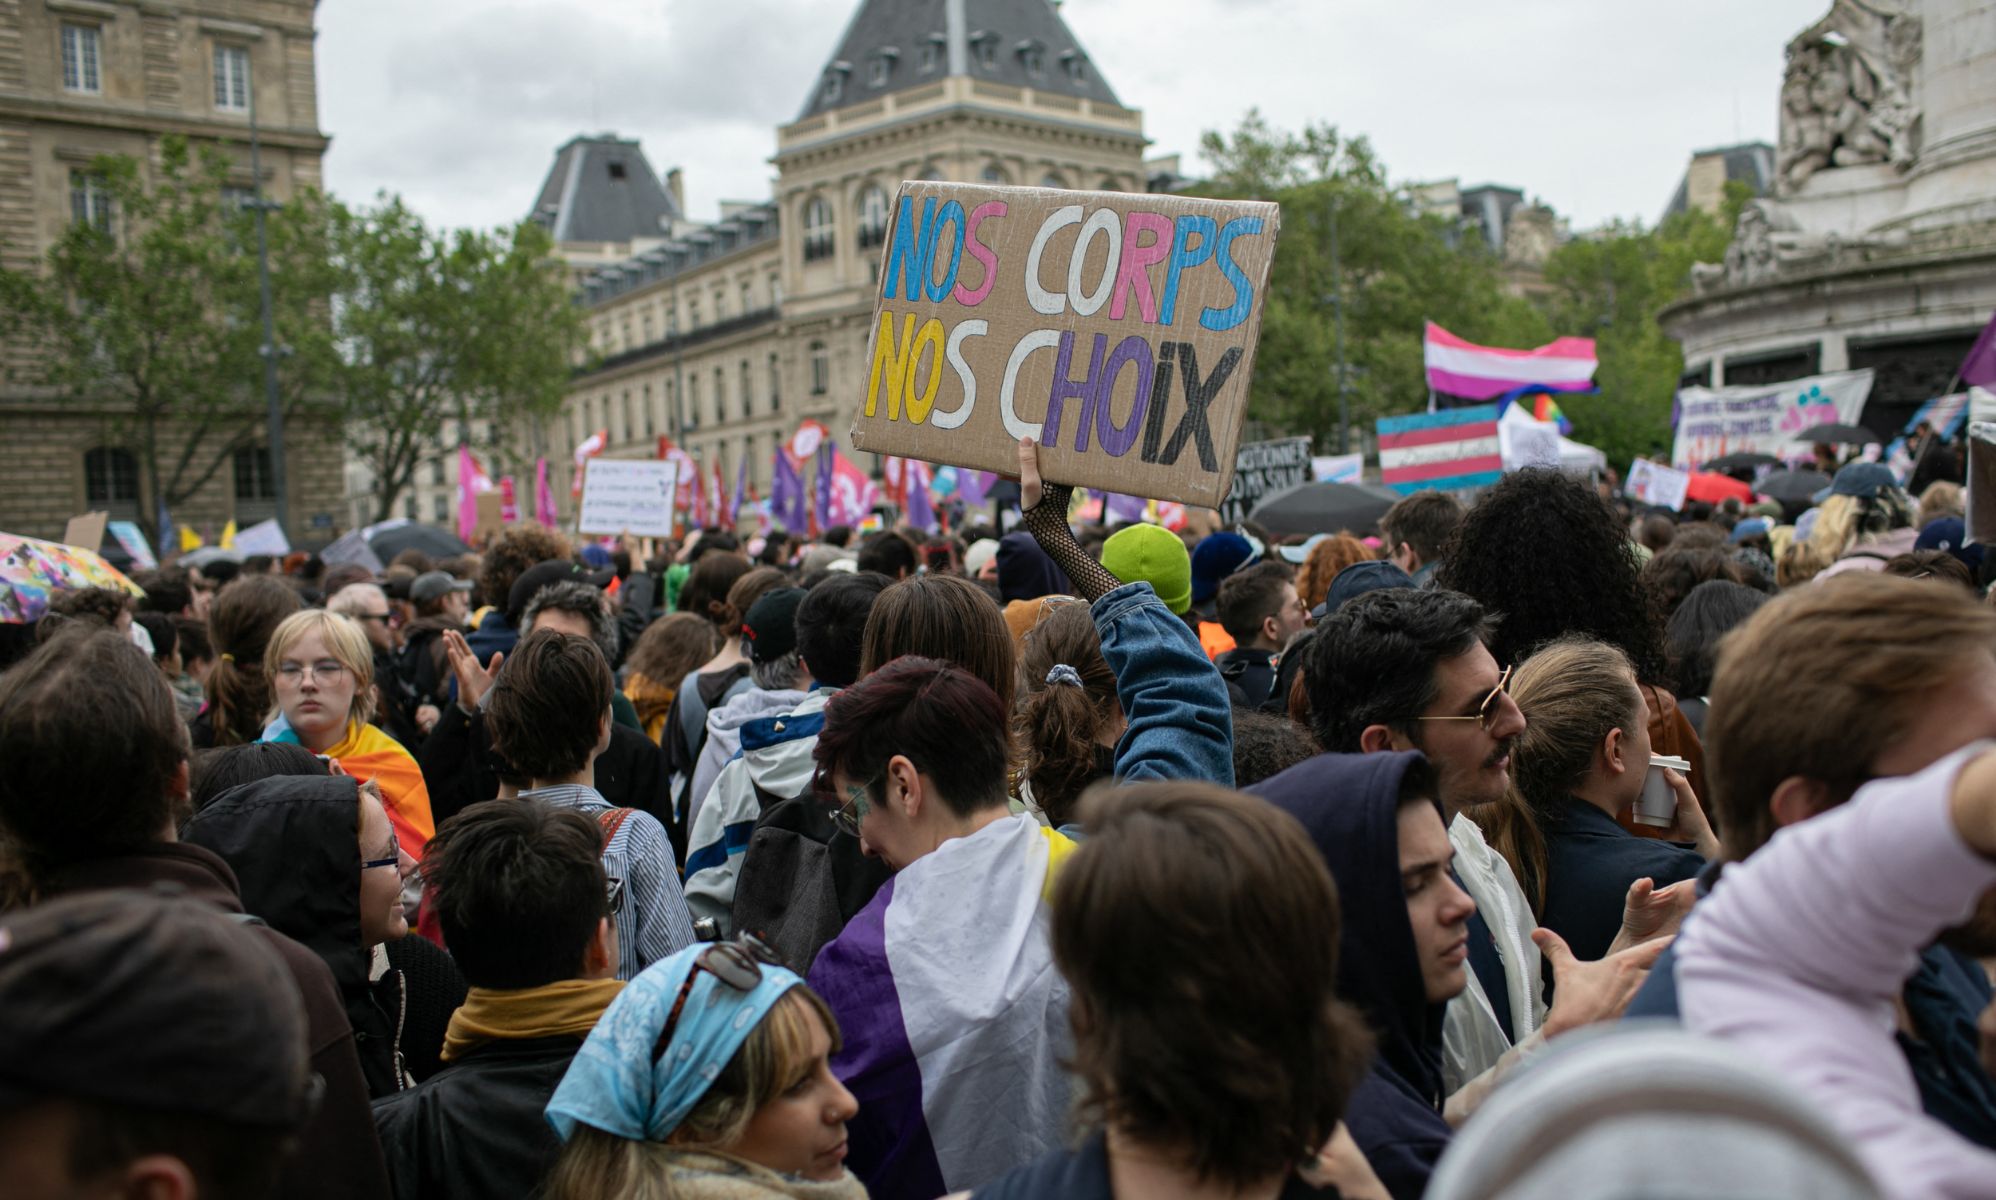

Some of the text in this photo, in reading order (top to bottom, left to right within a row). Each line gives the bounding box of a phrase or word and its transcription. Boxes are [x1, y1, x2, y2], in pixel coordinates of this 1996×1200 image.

[883, 195, 1264, 331] NOS CORPS
[864, 311, 988, 430] NOS
